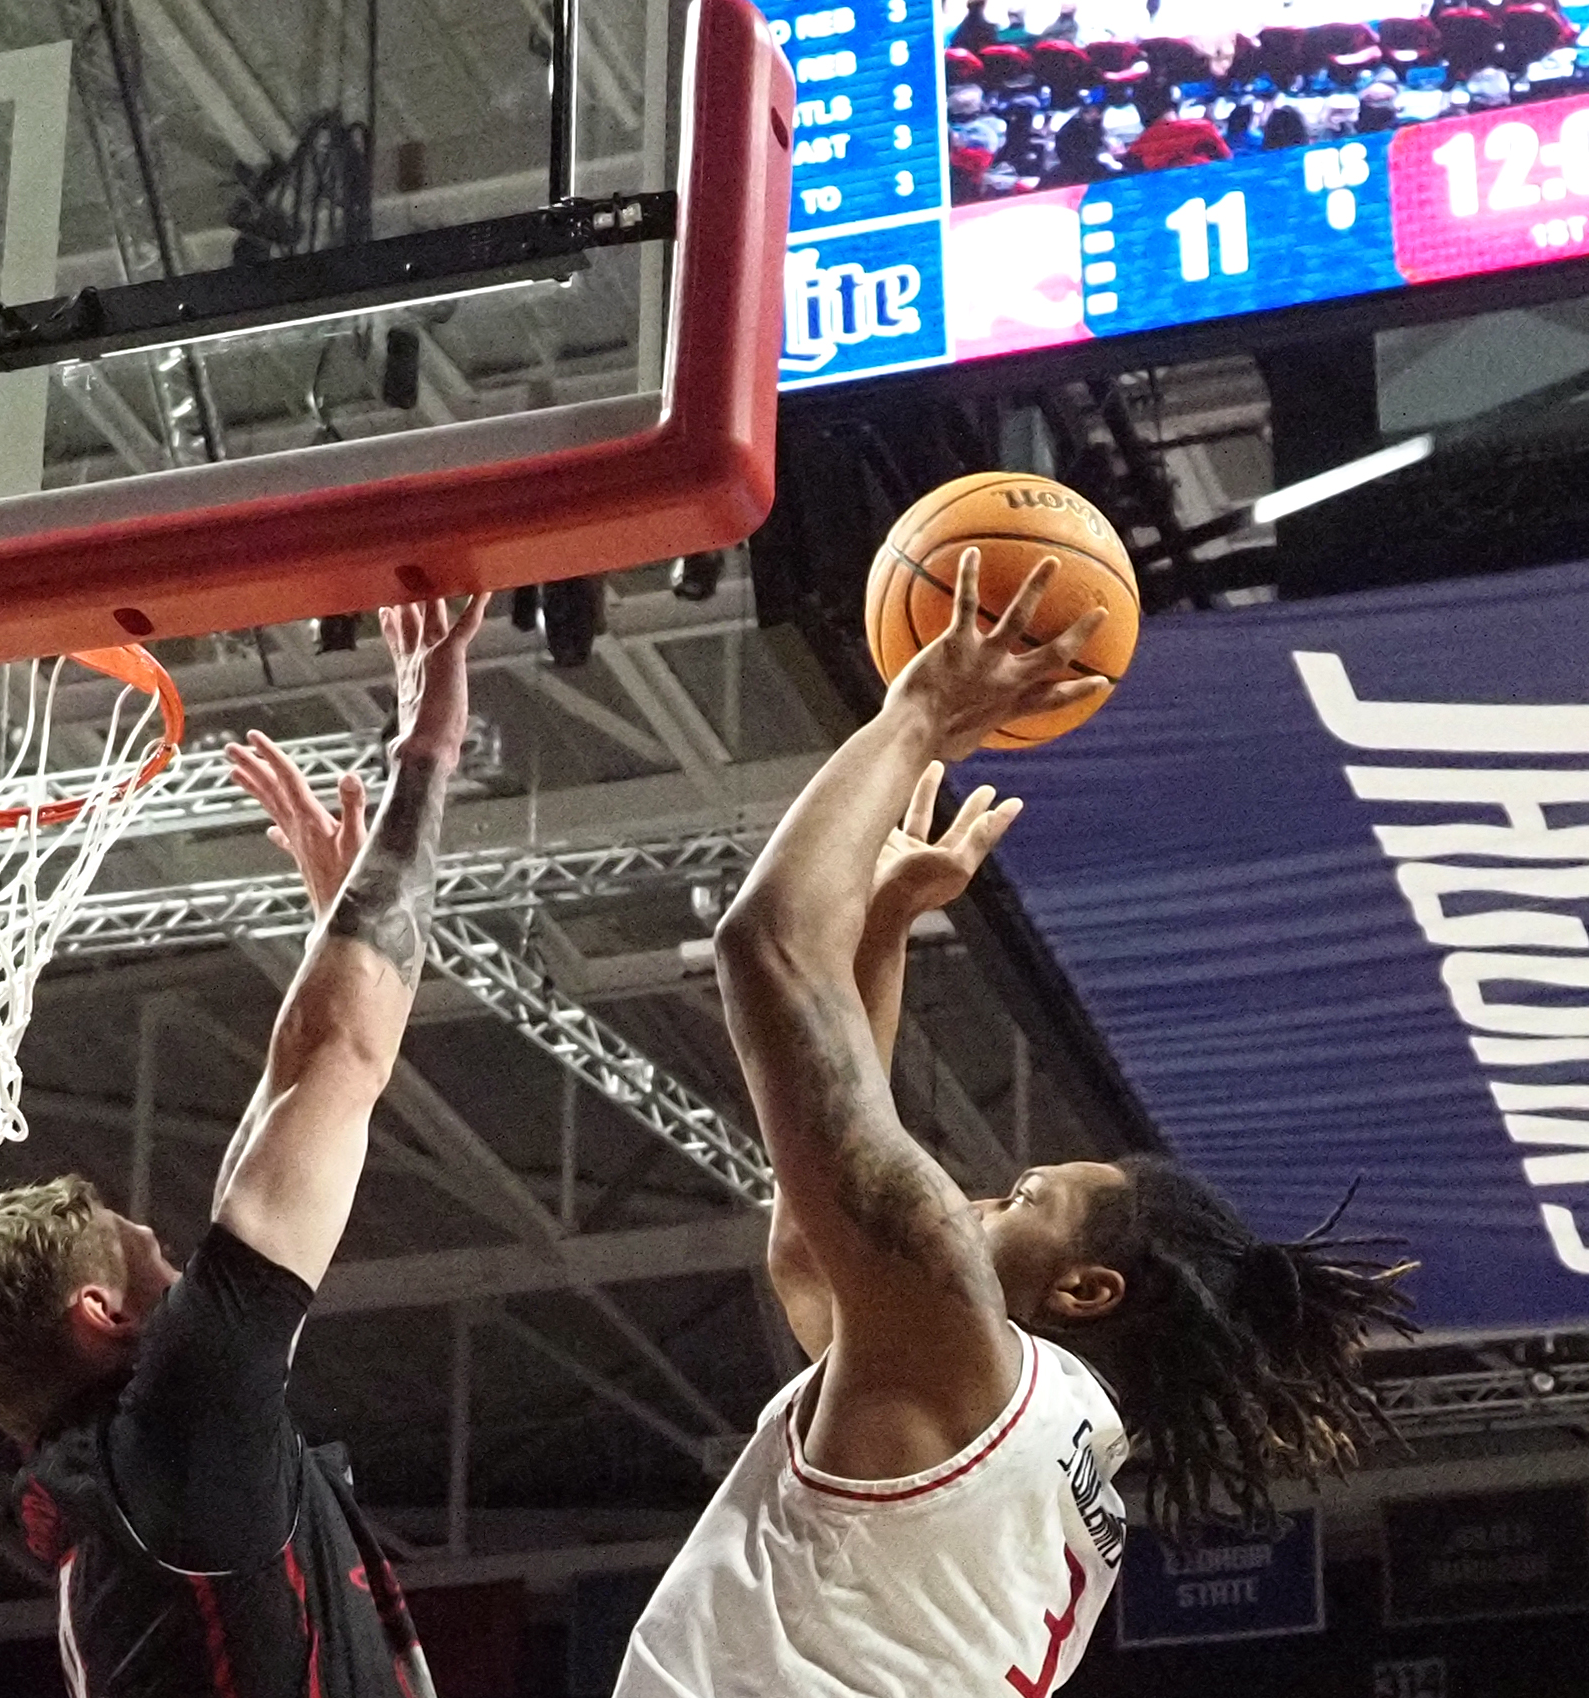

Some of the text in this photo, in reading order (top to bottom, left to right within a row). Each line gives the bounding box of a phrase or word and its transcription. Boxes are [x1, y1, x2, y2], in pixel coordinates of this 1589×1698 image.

[800, 170, 914, 214] TO 3
[1166, 191, 1250, 281] 11
[1175, 1577, 1260, 1608] STATE
